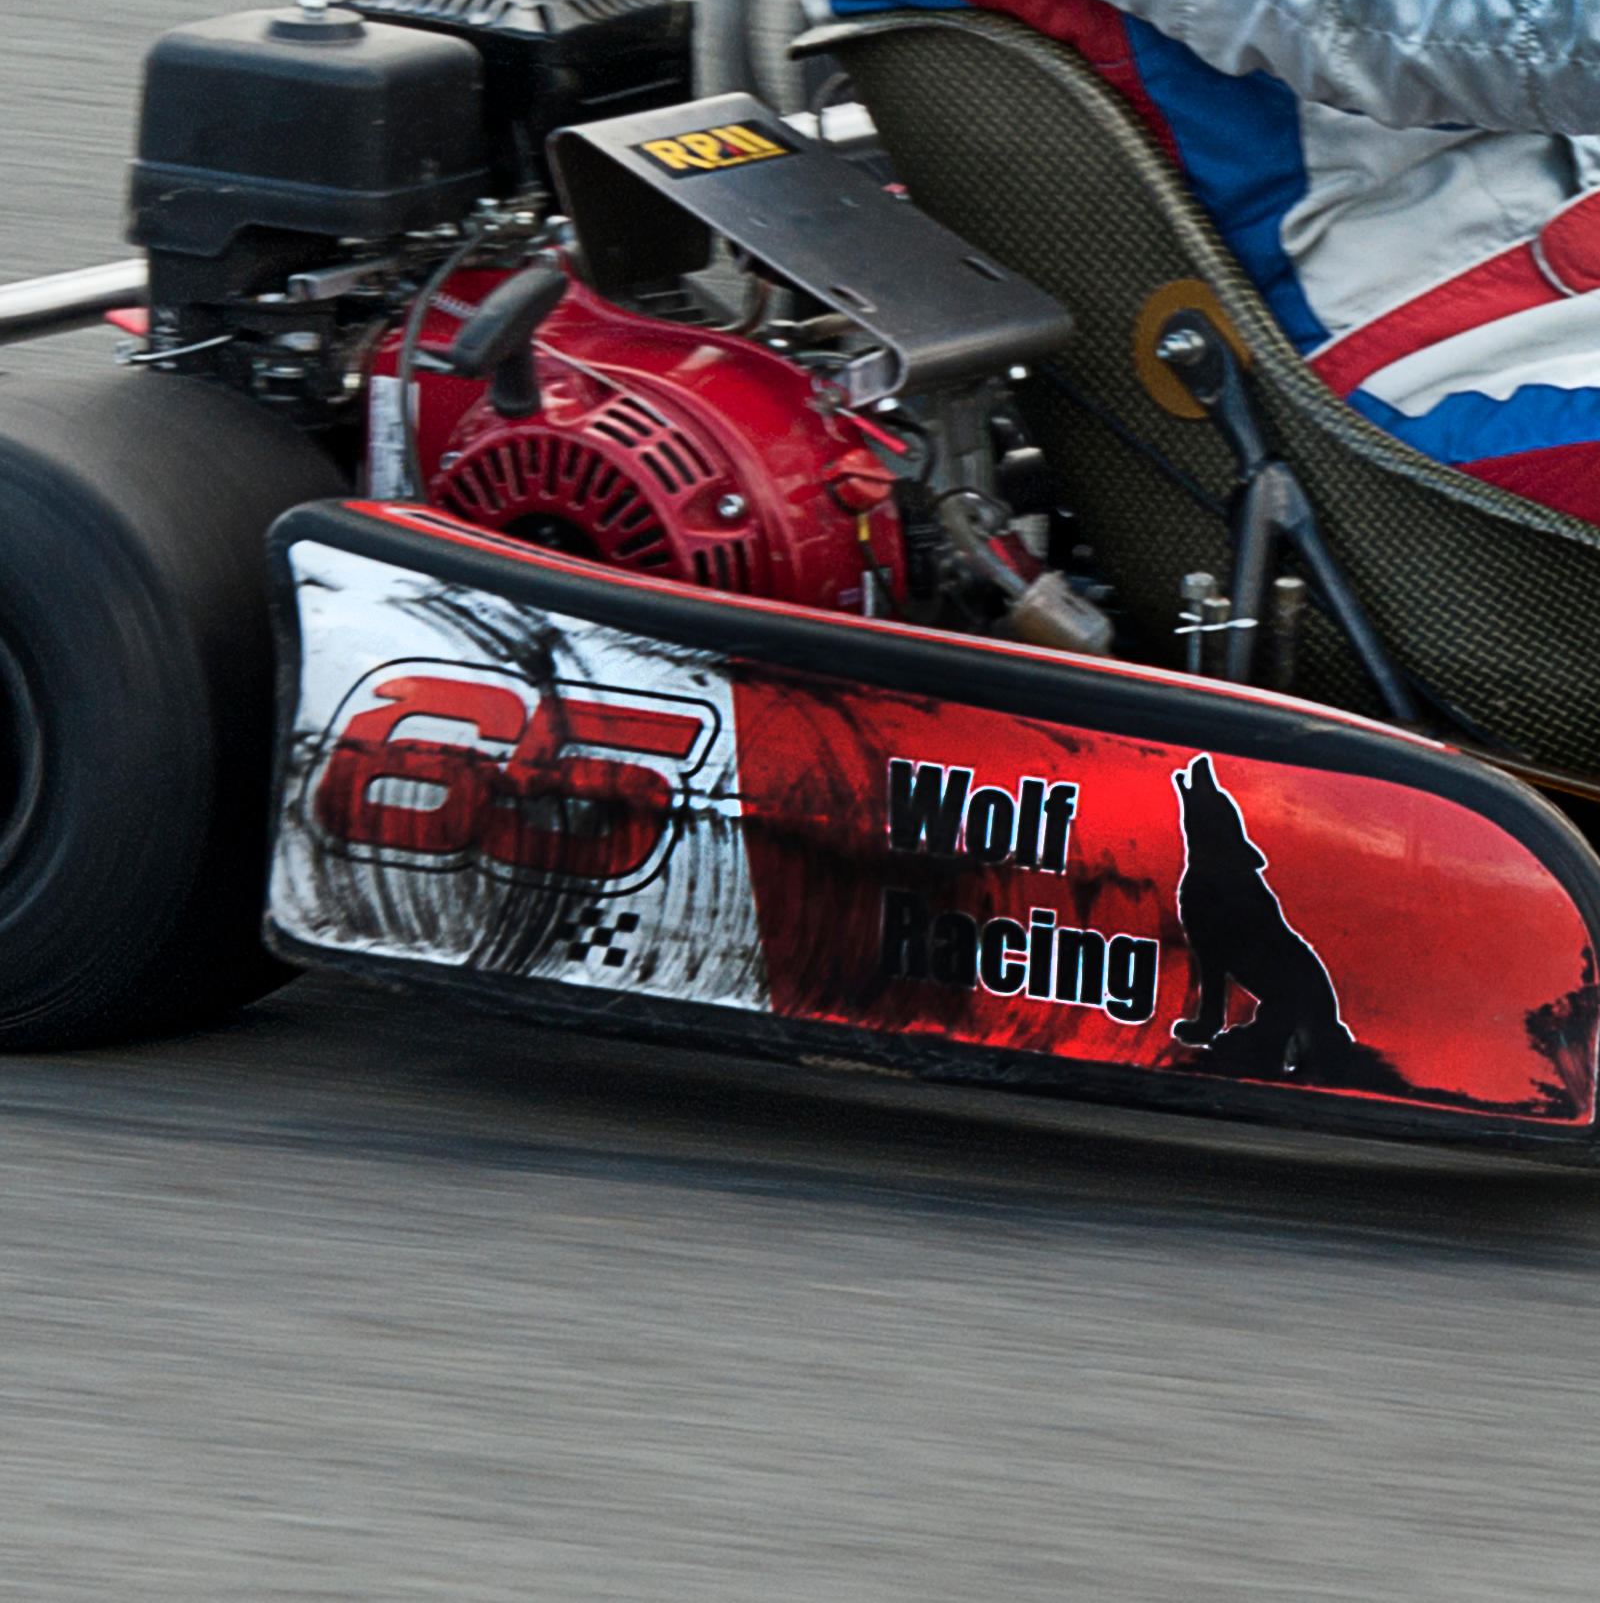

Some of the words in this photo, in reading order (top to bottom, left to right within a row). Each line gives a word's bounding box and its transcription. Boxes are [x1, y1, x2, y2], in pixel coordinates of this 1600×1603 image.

[314, 675, 703, 881] 65
[887, 756, 1080, 876] Wolf
[879, 884, 1160, 1026] Racing
